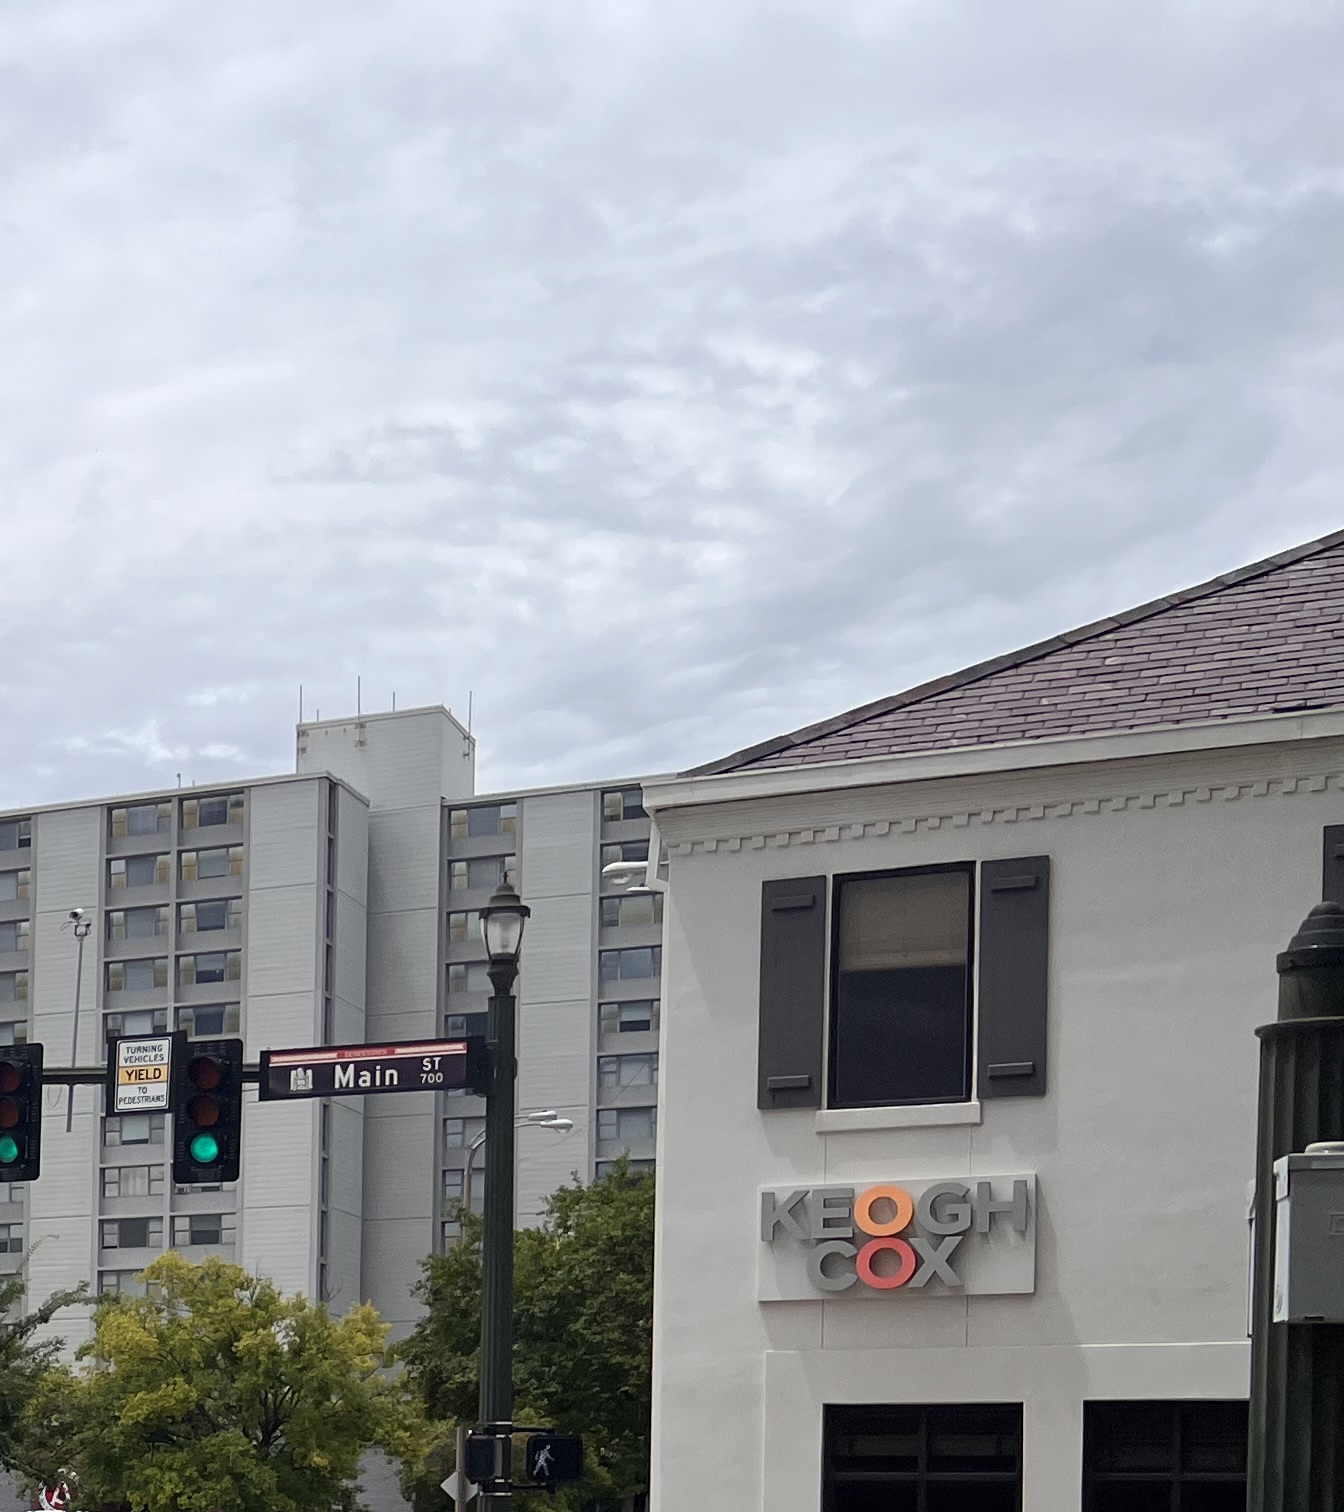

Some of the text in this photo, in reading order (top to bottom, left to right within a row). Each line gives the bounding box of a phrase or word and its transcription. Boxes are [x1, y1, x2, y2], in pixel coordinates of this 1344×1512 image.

[125, 1044, 163, 1055] TURNING
[123, 1053, 165, 1064] VEHICLES
[125, 1067, 162, 1081] YIELD
[334, 1056, 442, 1089] Main ST
[419, 1072, 444, 1085] 700
[137, 1086, 148, 1095] TO
[118, 1094, 165, 1105] PEDESTRIANS
[760, 1179, 1028, 1242] KEOGH
[810, 1235, 964, 1292] COX
